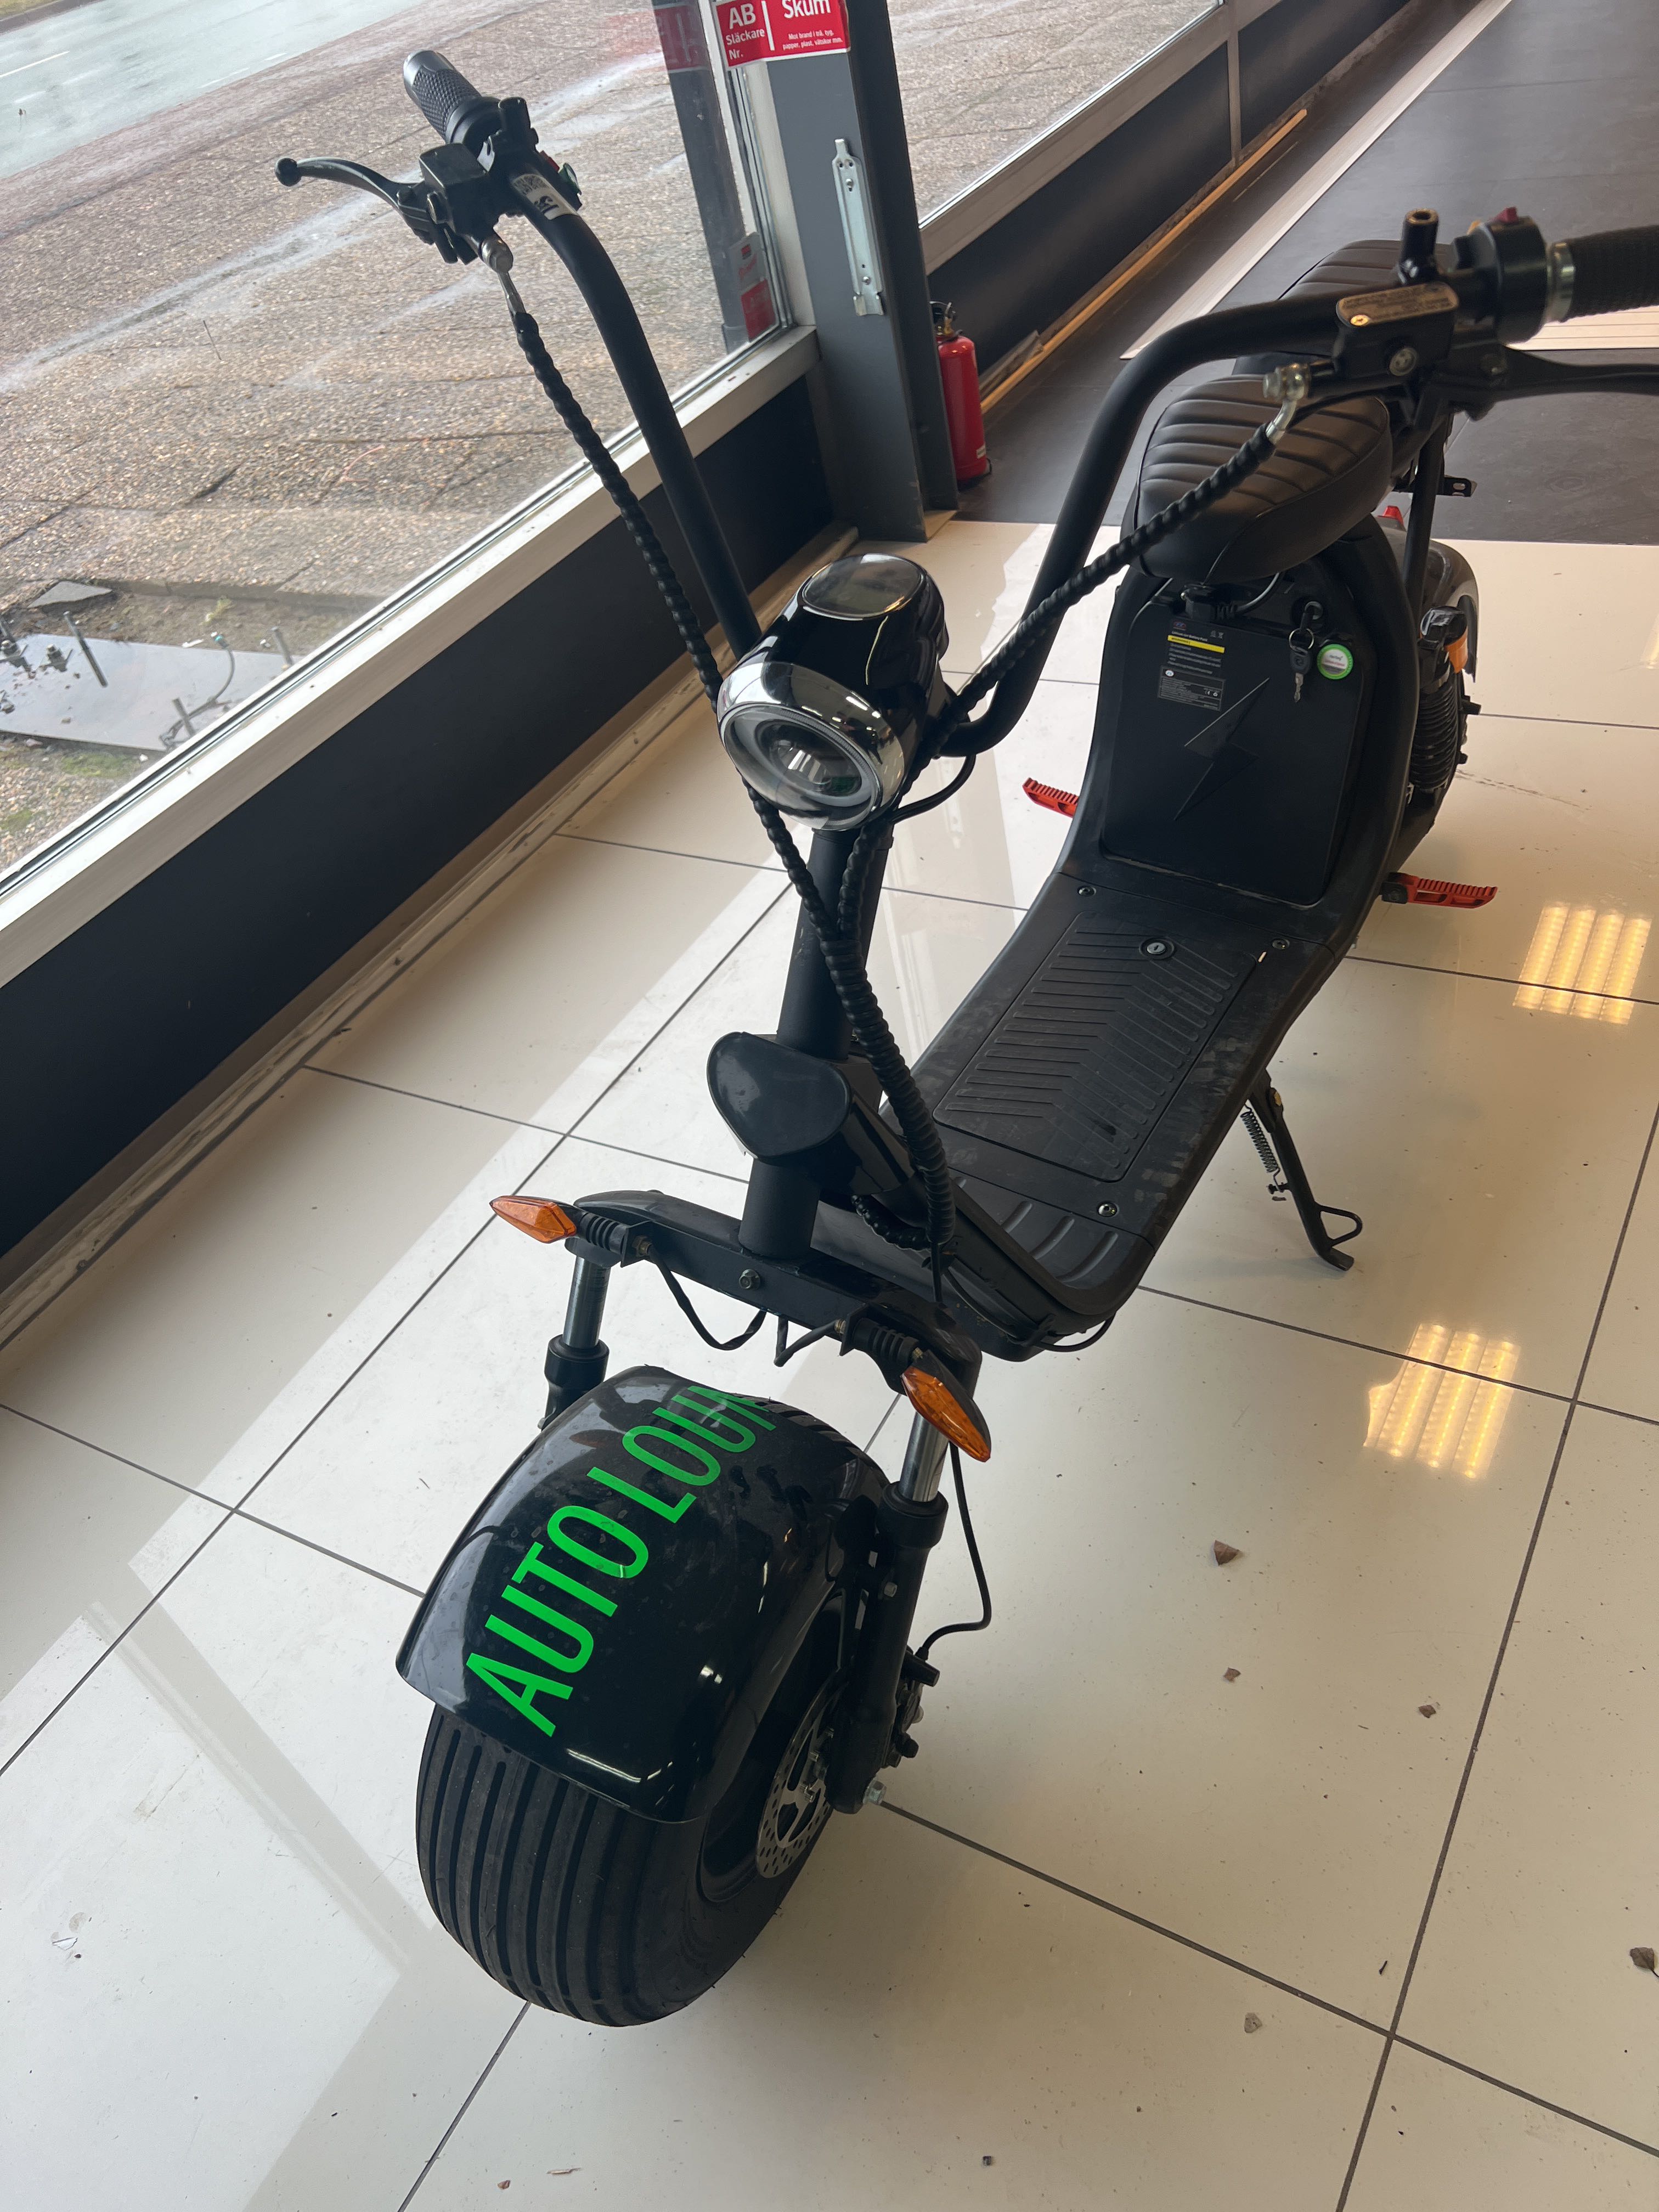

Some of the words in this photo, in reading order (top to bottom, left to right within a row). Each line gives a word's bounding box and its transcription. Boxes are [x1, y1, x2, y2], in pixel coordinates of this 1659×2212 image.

[729, 3, 756, 29] AB
[782, 0, 831, 18] Skum
[726, 29, 765, 45] Släckare
[729, 49, 743, 60] Nr.
[466, 1505, 648, 1737] AUTO
